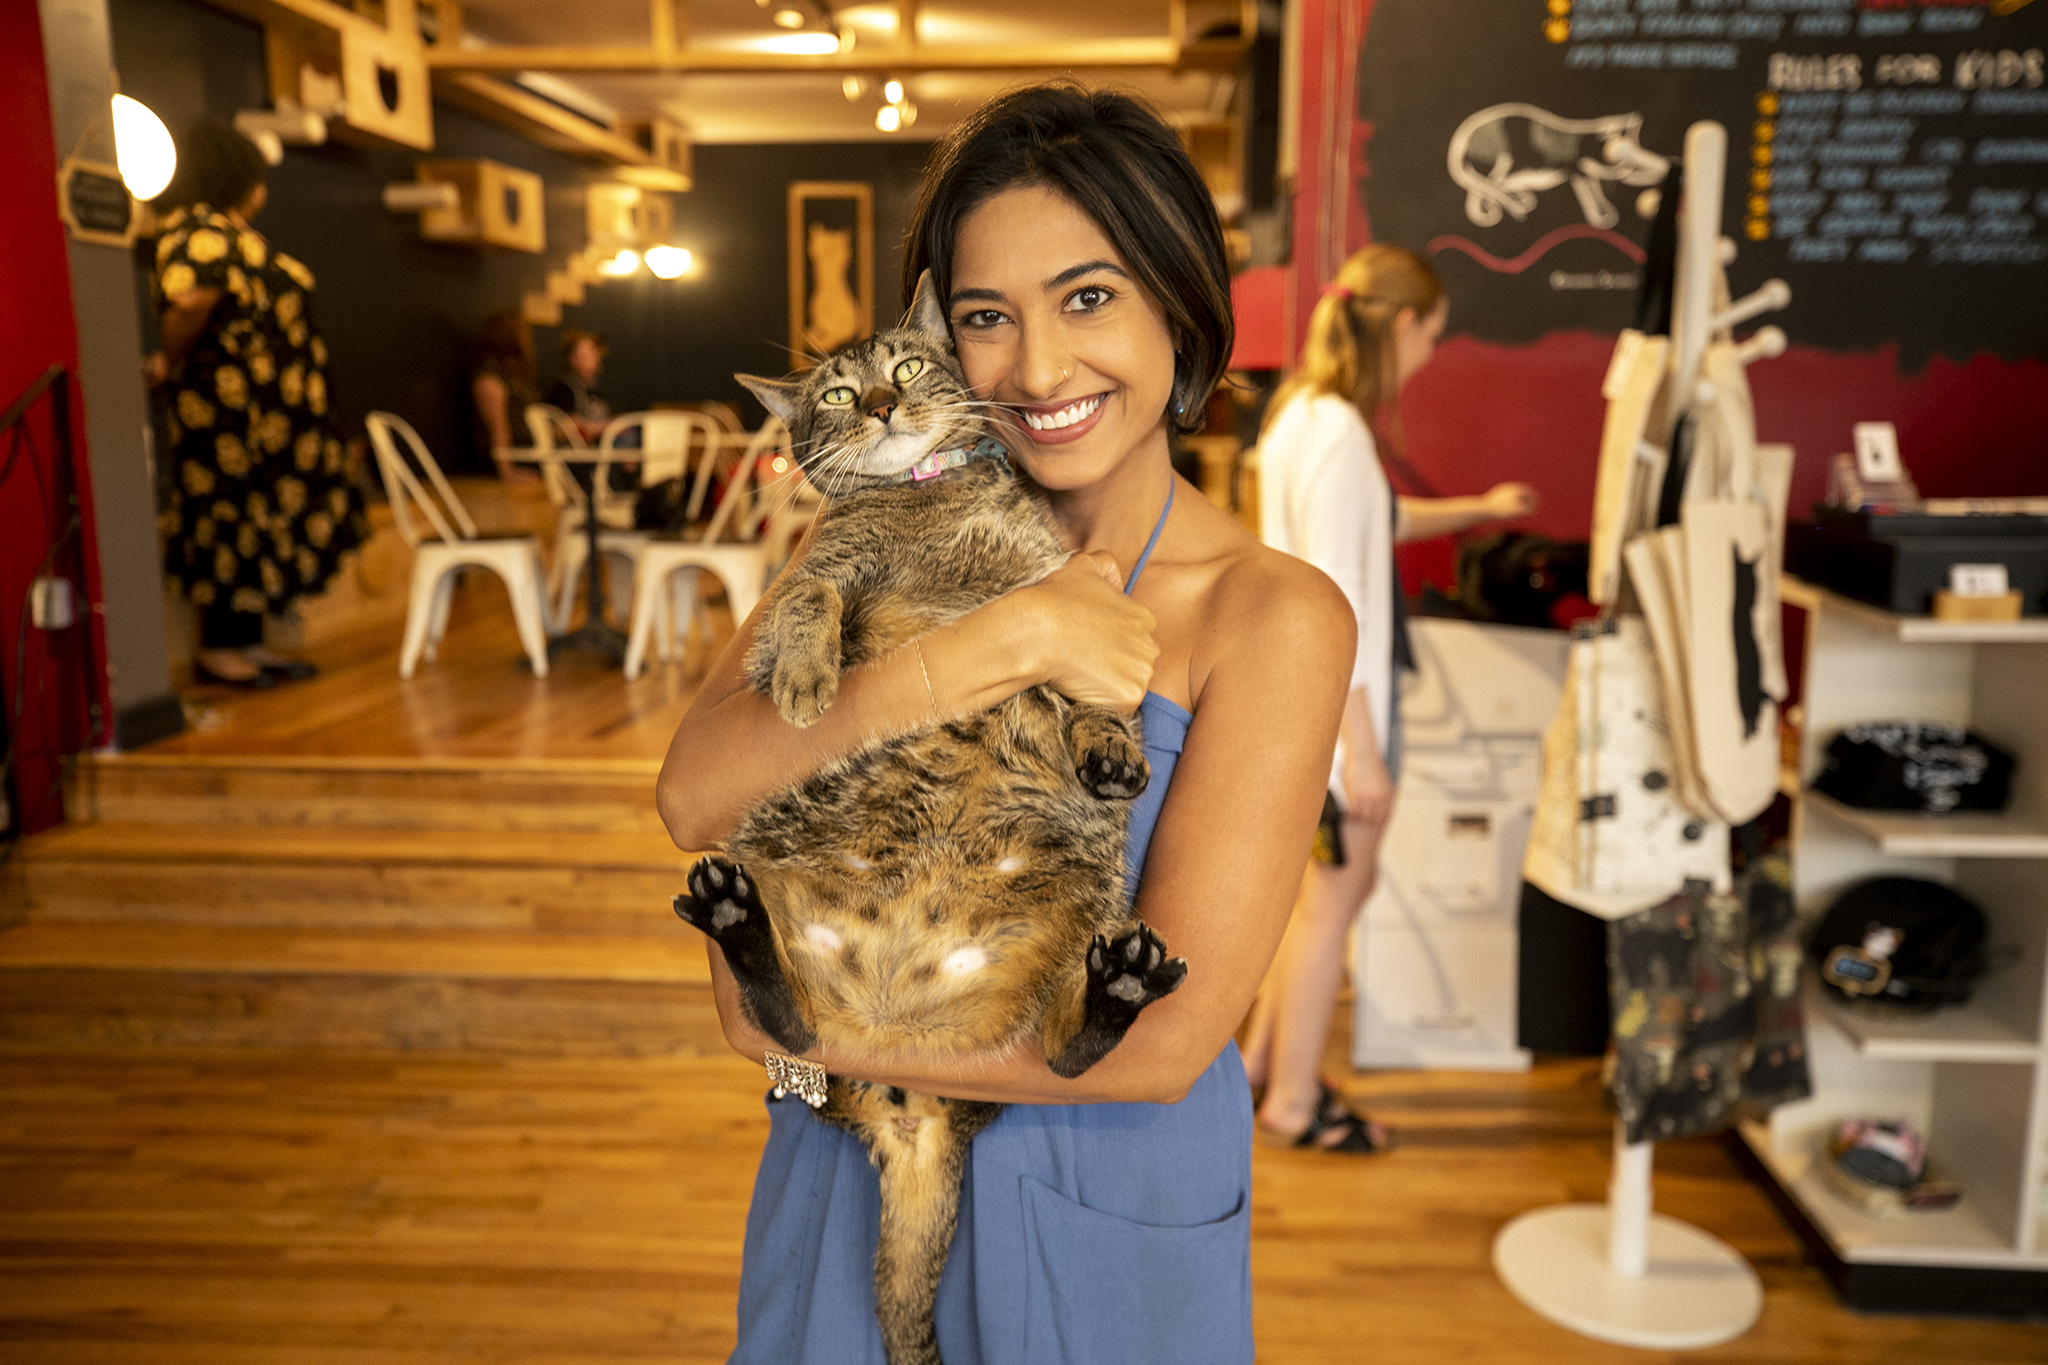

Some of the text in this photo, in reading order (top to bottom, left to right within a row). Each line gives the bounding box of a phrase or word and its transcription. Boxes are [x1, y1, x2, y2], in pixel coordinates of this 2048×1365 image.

[1768, 48, 2045, 92] RULES FOR KIDS
